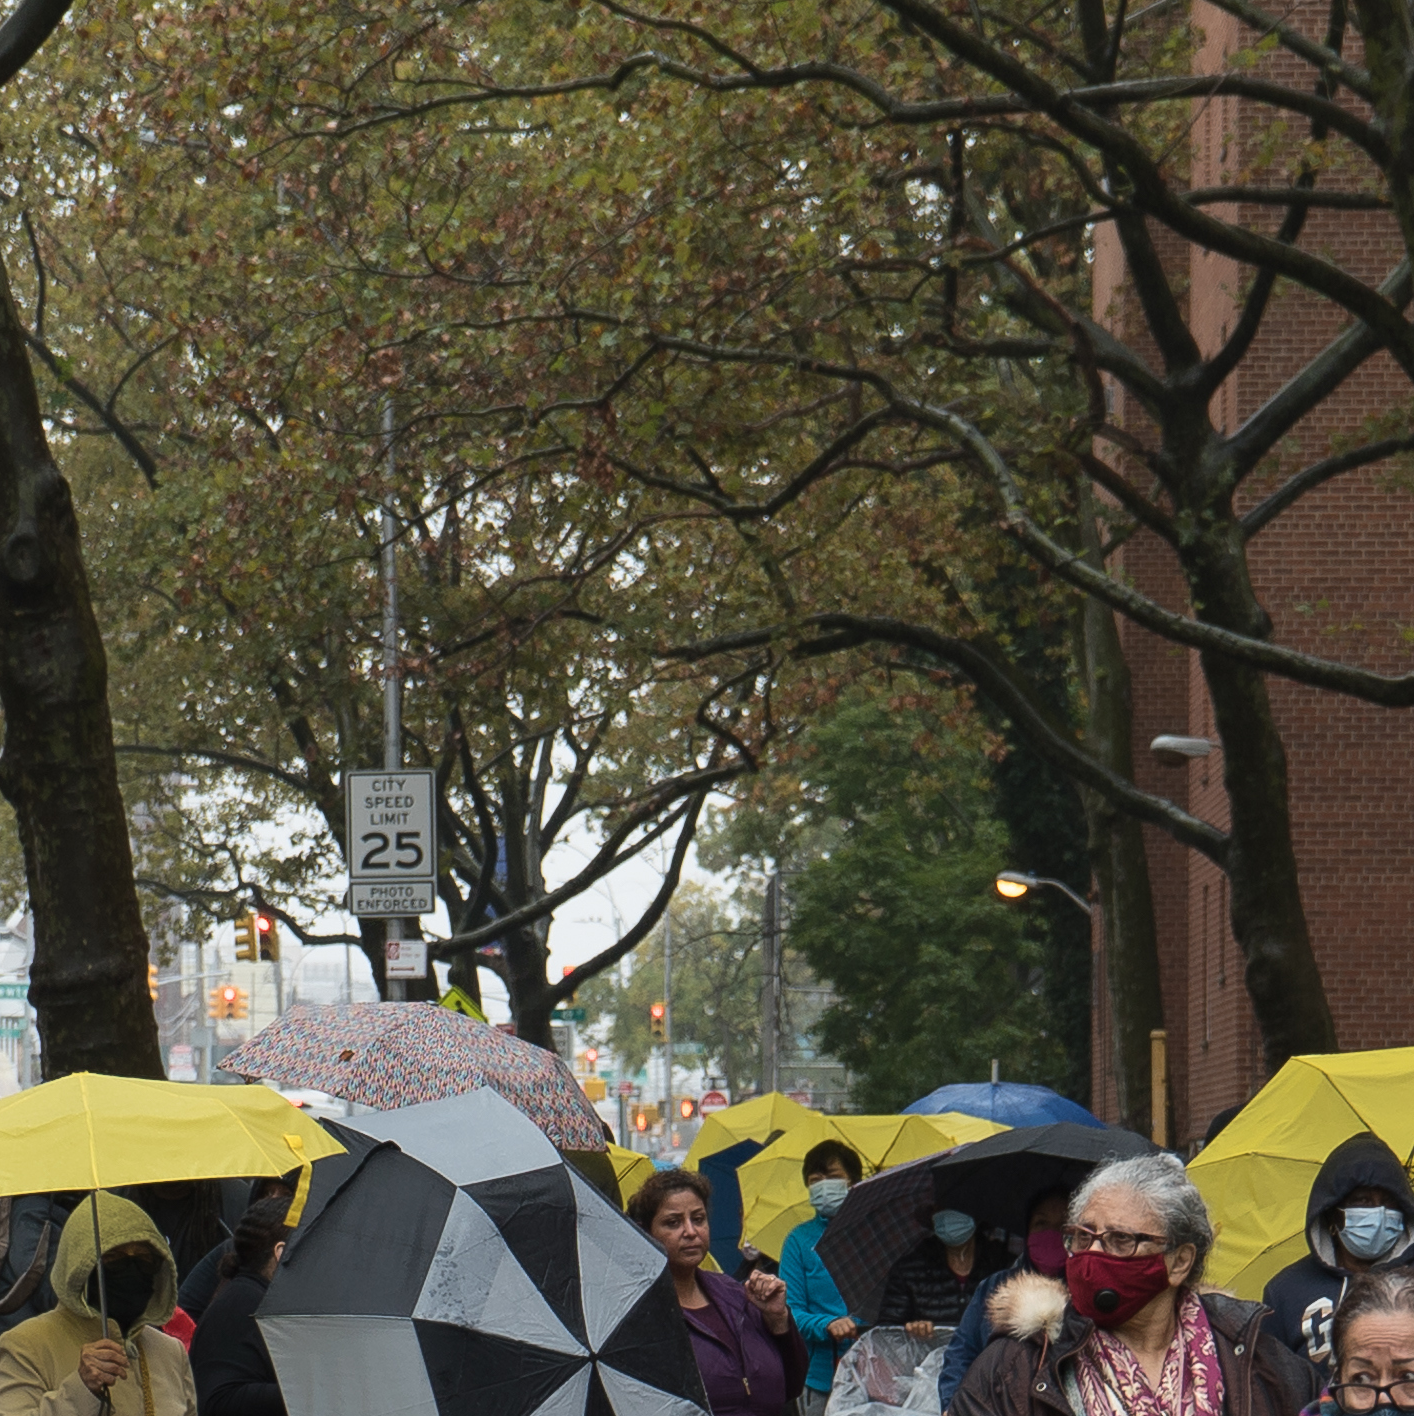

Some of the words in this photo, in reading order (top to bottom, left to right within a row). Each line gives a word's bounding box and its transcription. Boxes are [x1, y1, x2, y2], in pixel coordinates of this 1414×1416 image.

[371, 779, 406, 792] CITY
[365, 795, 415, 809] SPEED
[370, 812, 409, 826] LIMIT
[360, 831, 424, 870] 25
[370, 886, 414, 898] PHOTO
[356, 898, 427, 911] ENFORCED
